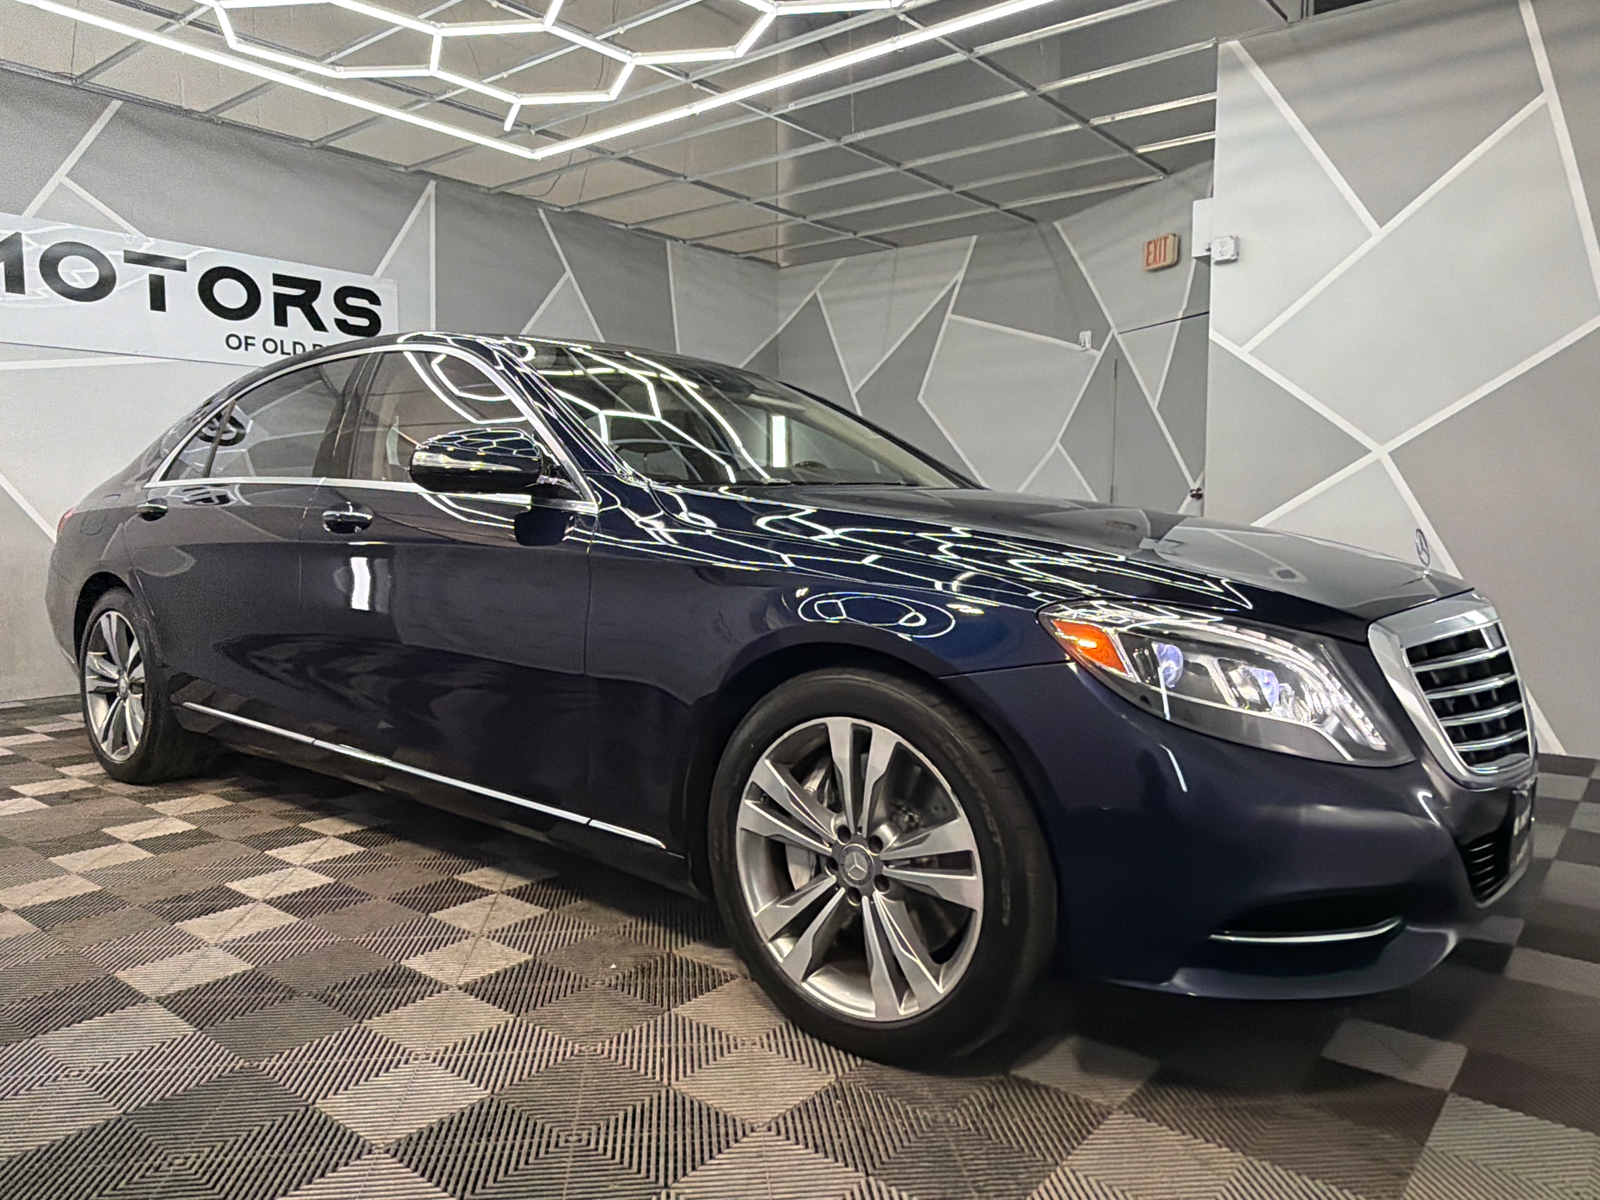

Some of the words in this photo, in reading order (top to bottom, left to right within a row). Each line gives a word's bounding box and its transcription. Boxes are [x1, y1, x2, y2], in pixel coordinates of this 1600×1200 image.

[1145, 236, 1169, 267] EXIT
[225, 333, 256, 352] OF
[262, 338, 306, 355] OLD
